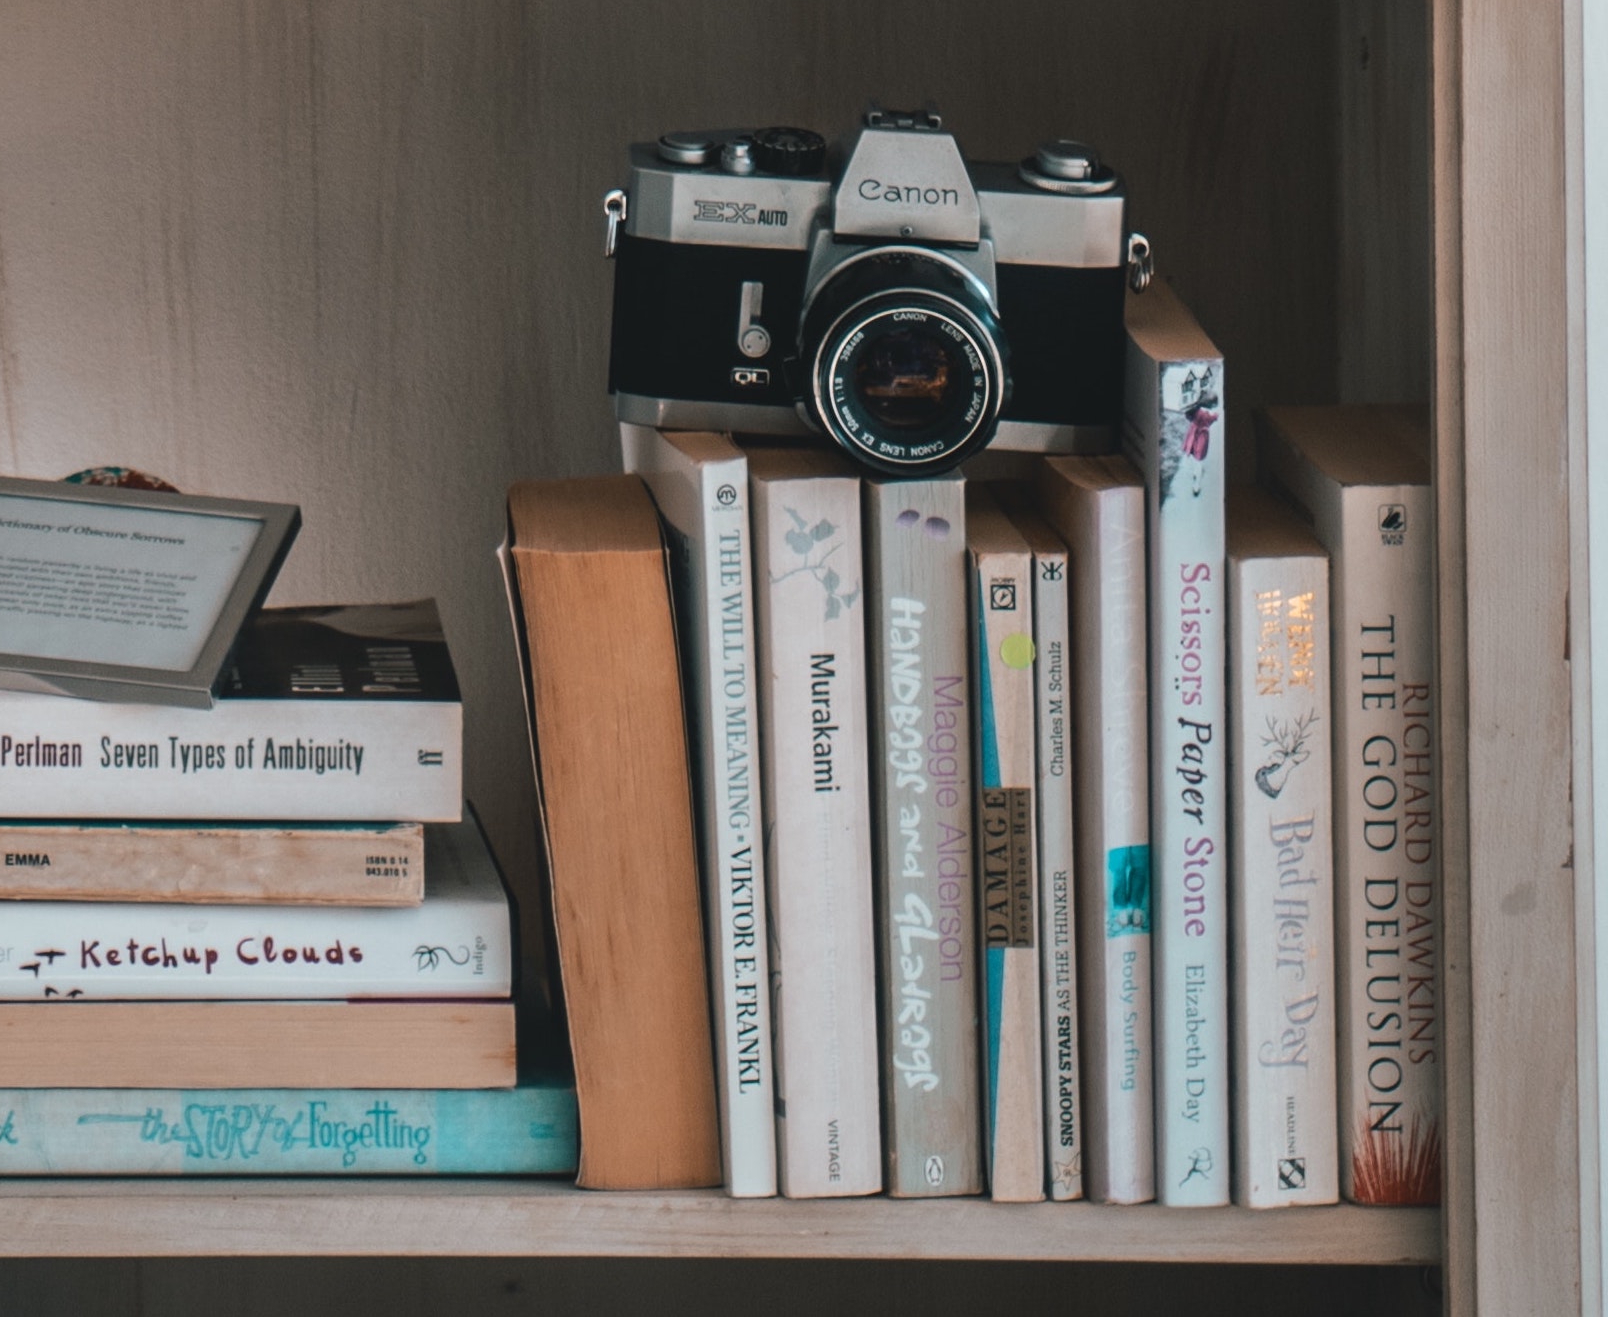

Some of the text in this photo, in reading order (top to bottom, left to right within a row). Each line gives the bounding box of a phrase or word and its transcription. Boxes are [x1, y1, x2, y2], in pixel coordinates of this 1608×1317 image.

[857, 180, 957, 205] Canon
[693, 200, 786, 226] EX AUTO
[893, 312, 927, 322] CANON
[941, 322, 963, 342] LENS
[963, 345, 981, 370] MADE
[964, 391, 981, 423] JAPAN
[57, 524, 71, 532] of
[74, 525, 126, 540] Obscure
[130, 531, 185, 545] Sorrows
[0, 736, 80, 766] Perlman
[100, 738, 158, 769] Seven
[167, 738, 225, 773] Types
[234, 738, 254, 769] of
[262, 738, 363, 773] Ambiguity
[1177, 564, 1215, 1124] Scissors Paper Stone Elizabeth Day
[4, 853, 50, 867] EMMA
[1360, 613, 1405, 1134] THE GOD DELUSION
[1401, 683, 1436, 1064] RICHARD DAWKINS
[812, 653, 841, 1181] Murakami VINTAGE
